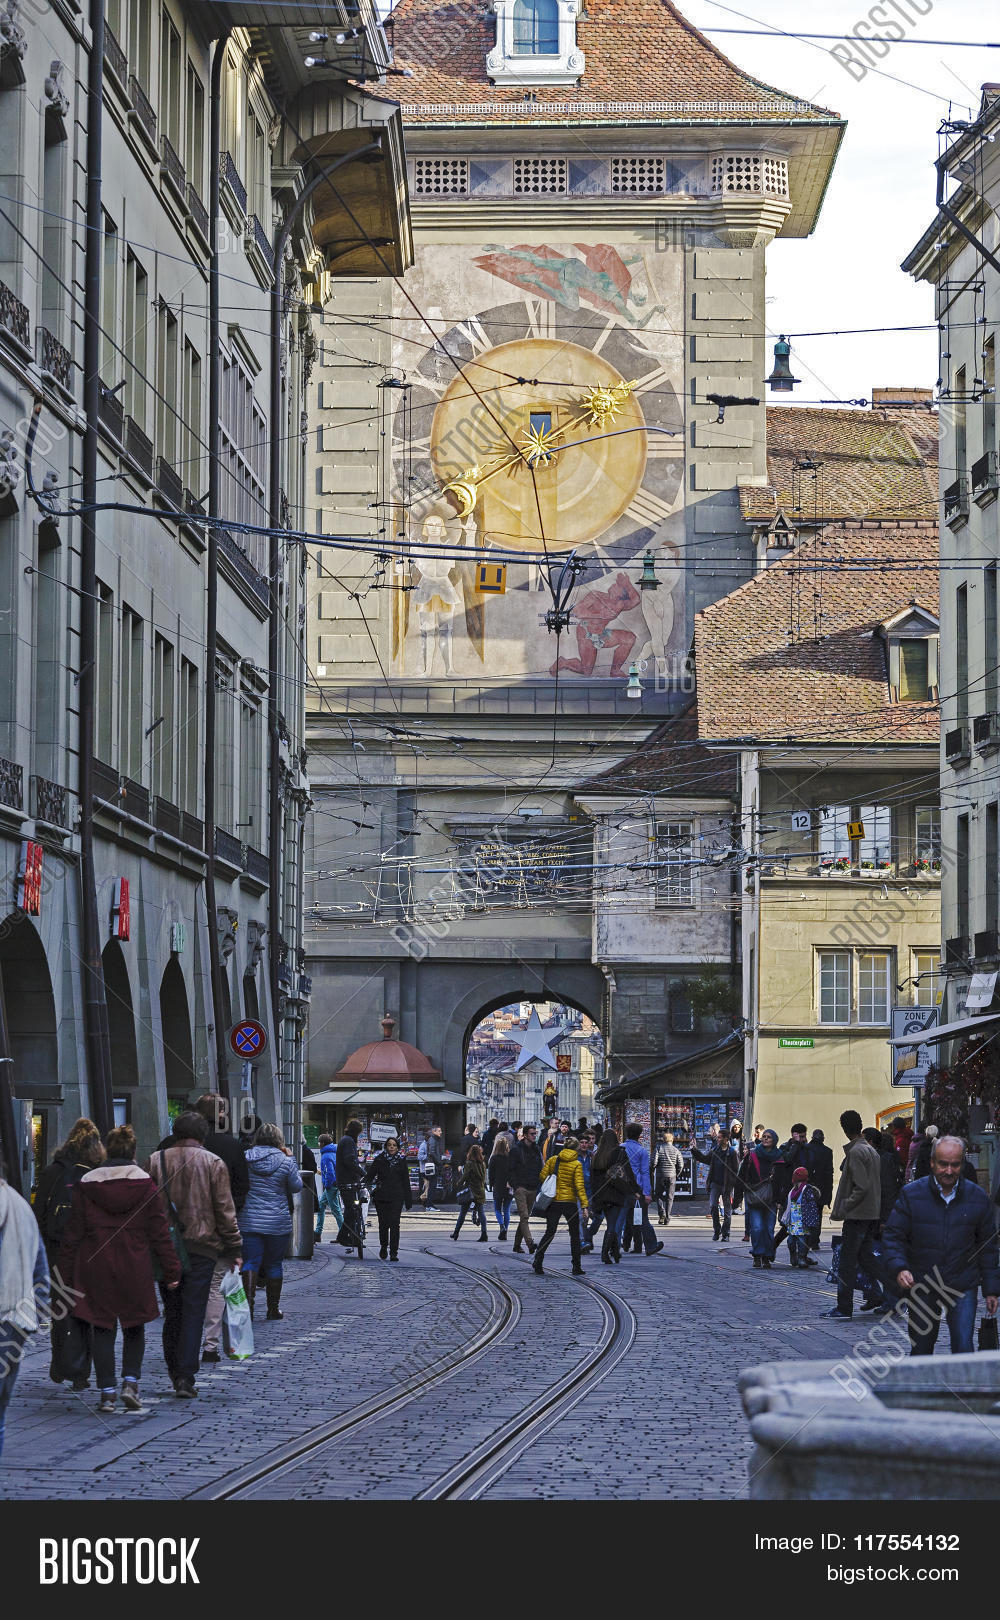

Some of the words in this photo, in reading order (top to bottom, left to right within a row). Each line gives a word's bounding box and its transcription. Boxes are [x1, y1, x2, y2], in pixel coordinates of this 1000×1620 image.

[793, 816, 809, 828] 12
[904, 1012, 926, 1021] ZONE
[782, 1039, 812, 1047] Theaterplatz
